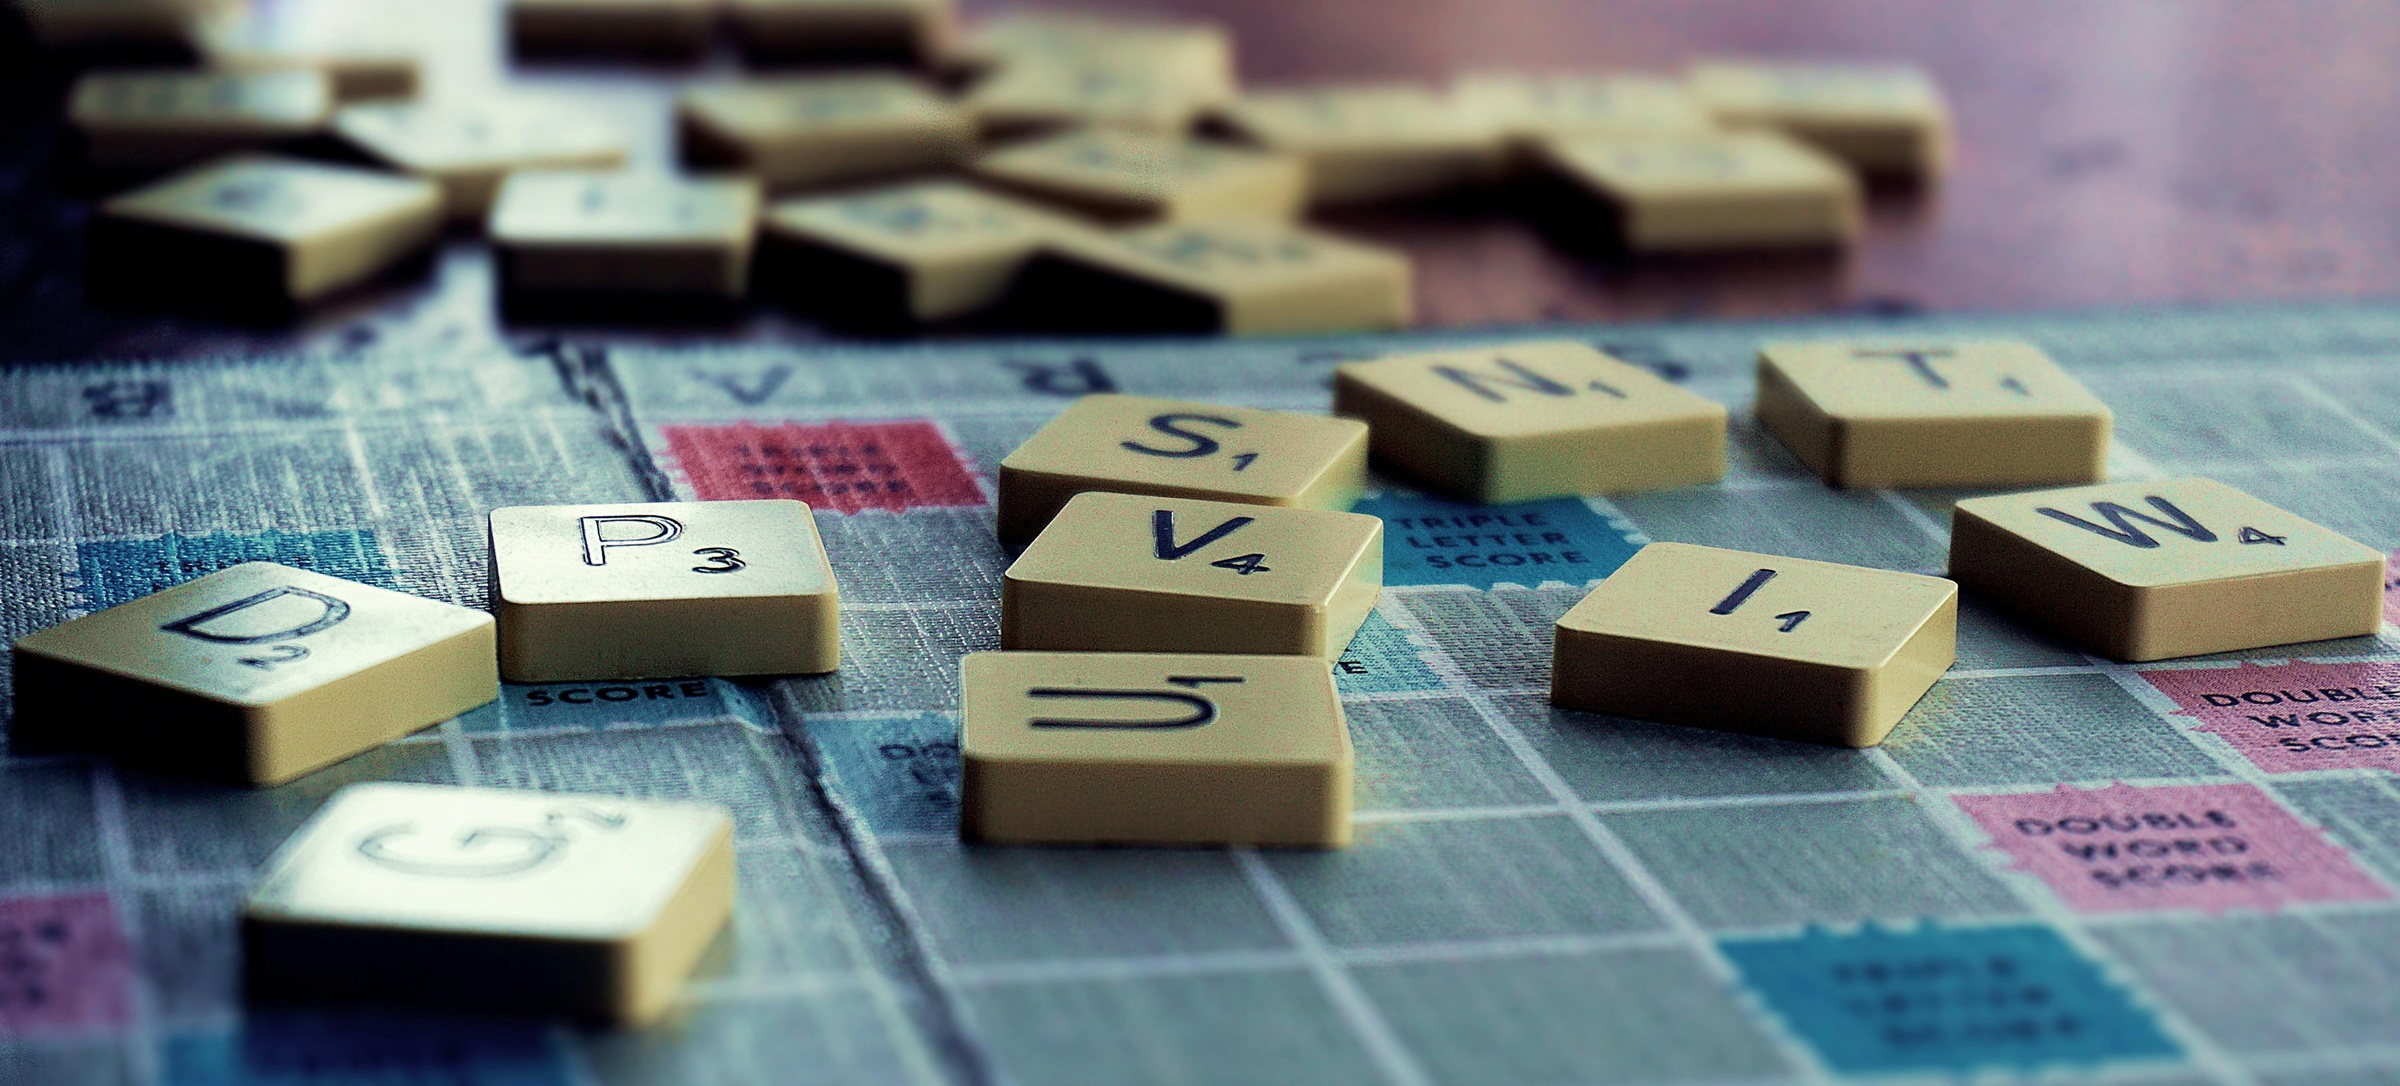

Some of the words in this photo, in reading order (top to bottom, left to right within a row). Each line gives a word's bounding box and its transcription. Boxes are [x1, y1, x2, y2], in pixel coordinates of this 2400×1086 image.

[1430, 355, 1578, 403] N
[1850, 349, 1955, 389] T
[1119, 412, 1243, 458] S
[577, 514, 684, 566] P
[1151, 509, 1256, 561] V
[1390, 513, 1549, 530] TRIPLE
[1406, 532, 1569, 549] LETTER
[2034, 495, 2219, 549] W
[1425, 550, 1590, 569] SCORE
[159, 584, 351, 645] D
[526, 681, 709, 706] SCORE
[1027, 686, 1221, 731] U
[2014, 810, 2237, 836] DOUBLE
[356, 822, 567, 879] G
[2059, 837, 2247, 861] WORD
